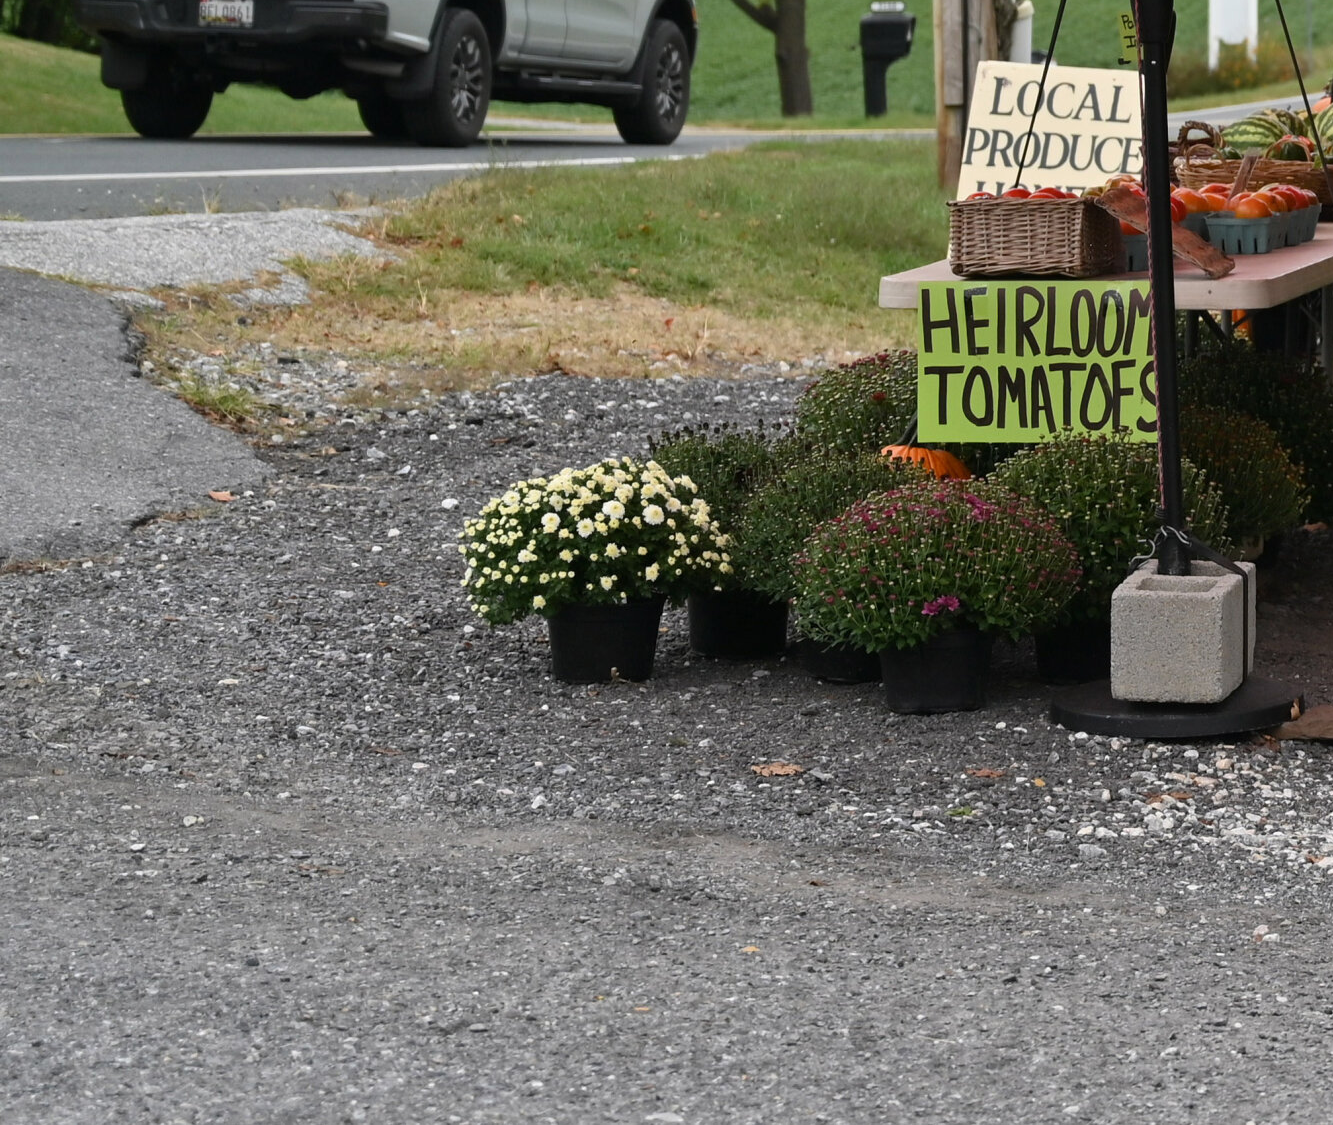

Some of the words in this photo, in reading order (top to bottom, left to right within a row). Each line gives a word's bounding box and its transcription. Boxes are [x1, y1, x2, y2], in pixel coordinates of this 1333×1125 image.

[989, 76, 1132, 124] LOCAL
[962, 127, 1143, 175] PRODUCE
[921, 285, 1157, 357] HEIRLOOM
